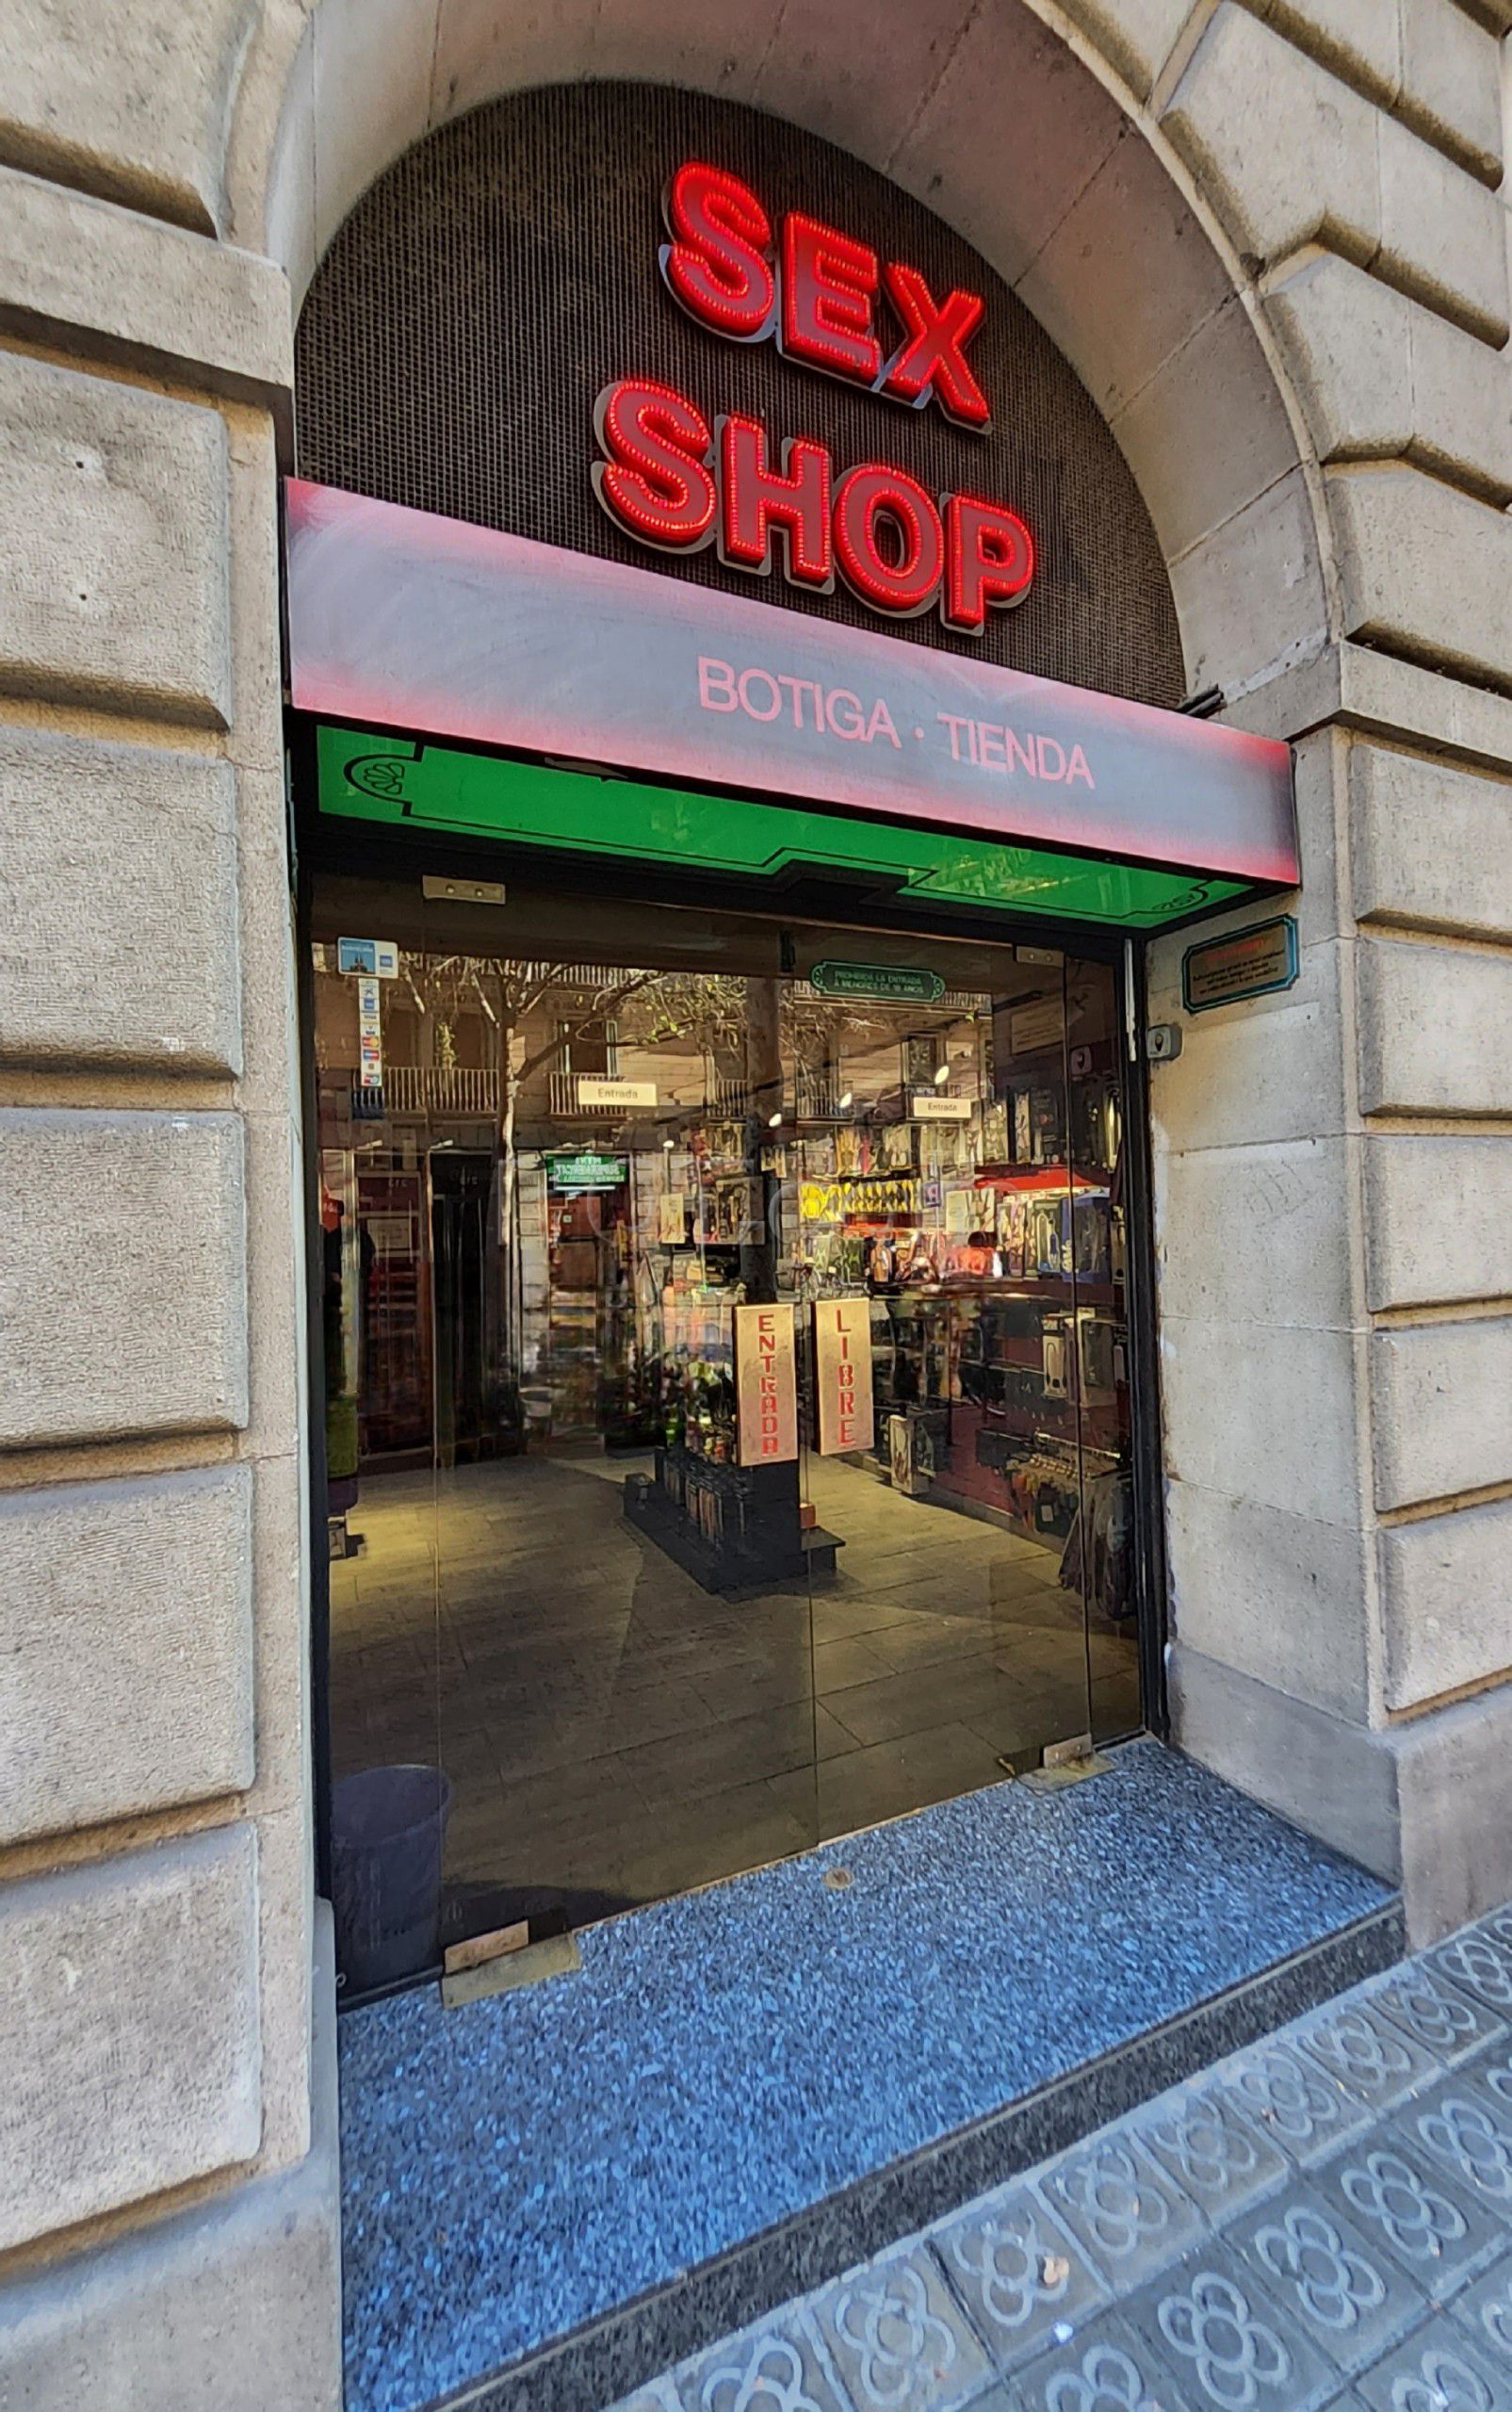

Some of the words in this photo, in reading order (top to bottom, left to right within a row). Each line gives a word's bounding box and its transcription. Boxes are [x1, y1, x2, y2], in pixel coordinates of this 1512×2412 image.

[661, 161, 991, 432] SEX
[593, 379, 1033, 635] SHOP
[698, 656, 902, 748] BOTIGA
[936, 712, 1096, 790] TIENDA
[597, 1087, 639, 1100] Entrada
[927, 1101, 958, 1112] Entrada
[757, 1313, 779, 1456] ENTRADA
[836, 1309, 855, 1445] LIBRE
